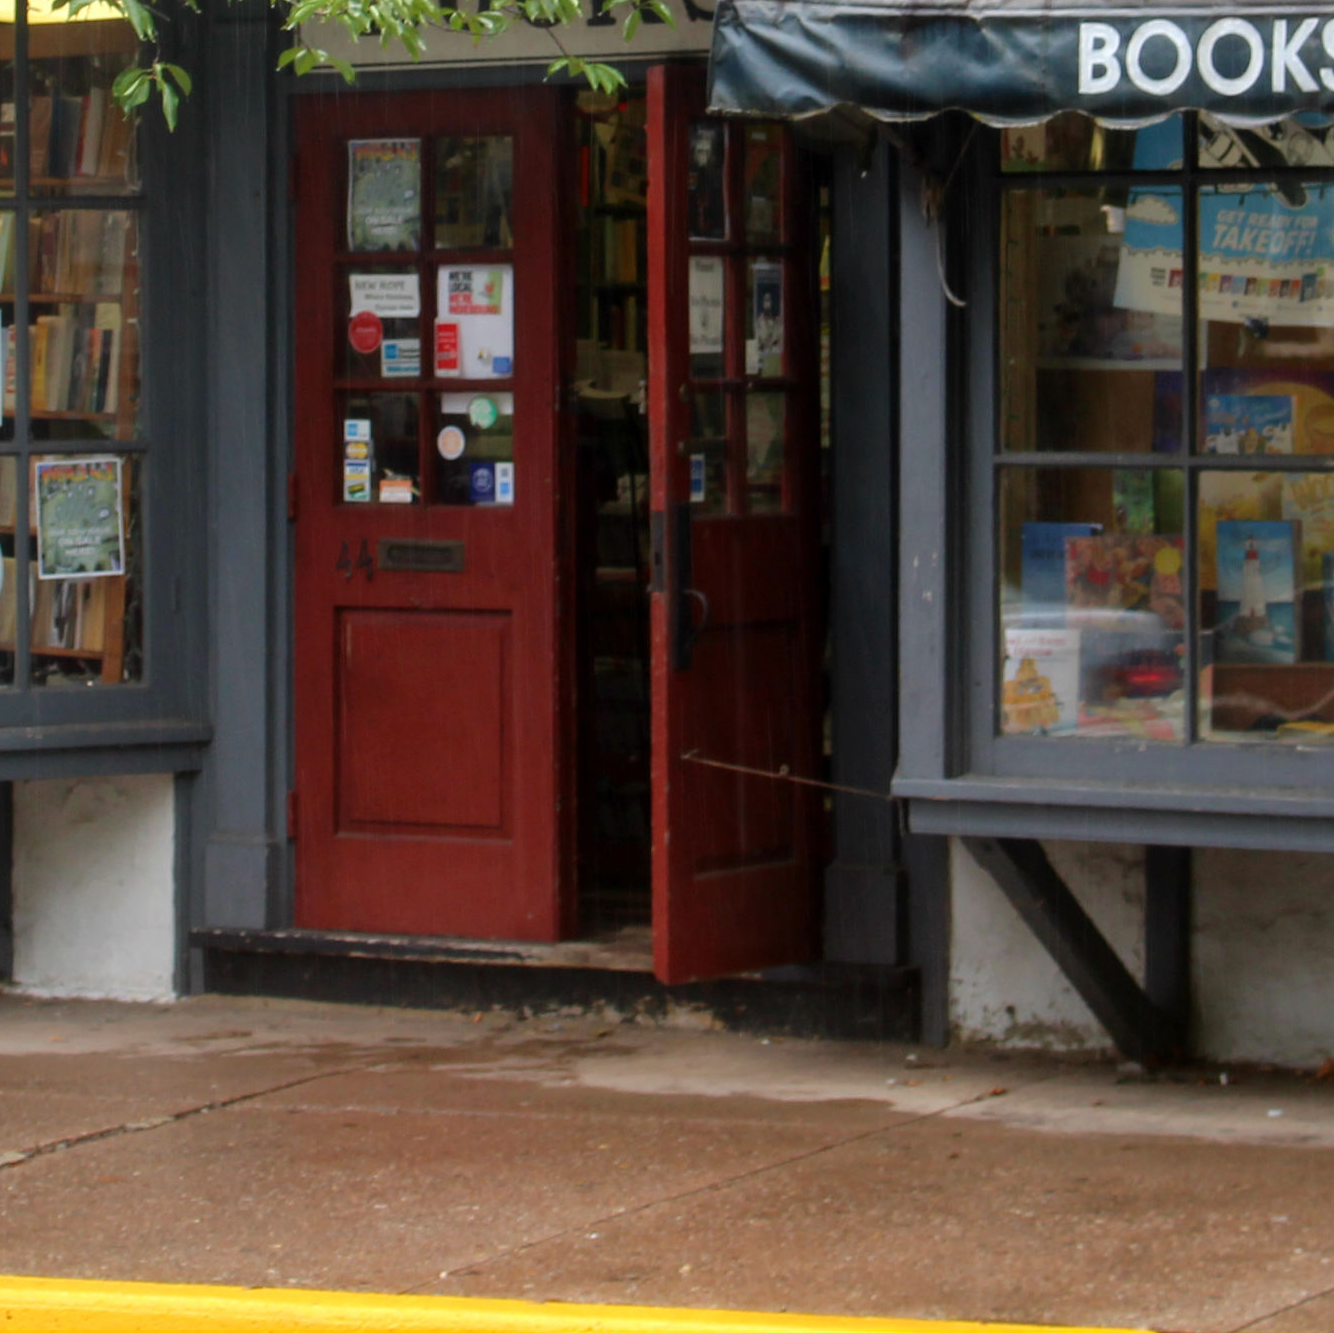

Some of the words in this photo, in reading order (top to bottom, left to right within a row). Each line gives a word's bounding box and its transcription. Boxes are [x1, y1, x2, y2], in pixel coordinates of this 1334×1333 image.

[1217, 209, 1248, 225] GET
[1248, 211, 1296, 228] READY
[1296, 215, 1319, 230] FOR
[1212, 224, 1317, 255] TAKEOFF!
